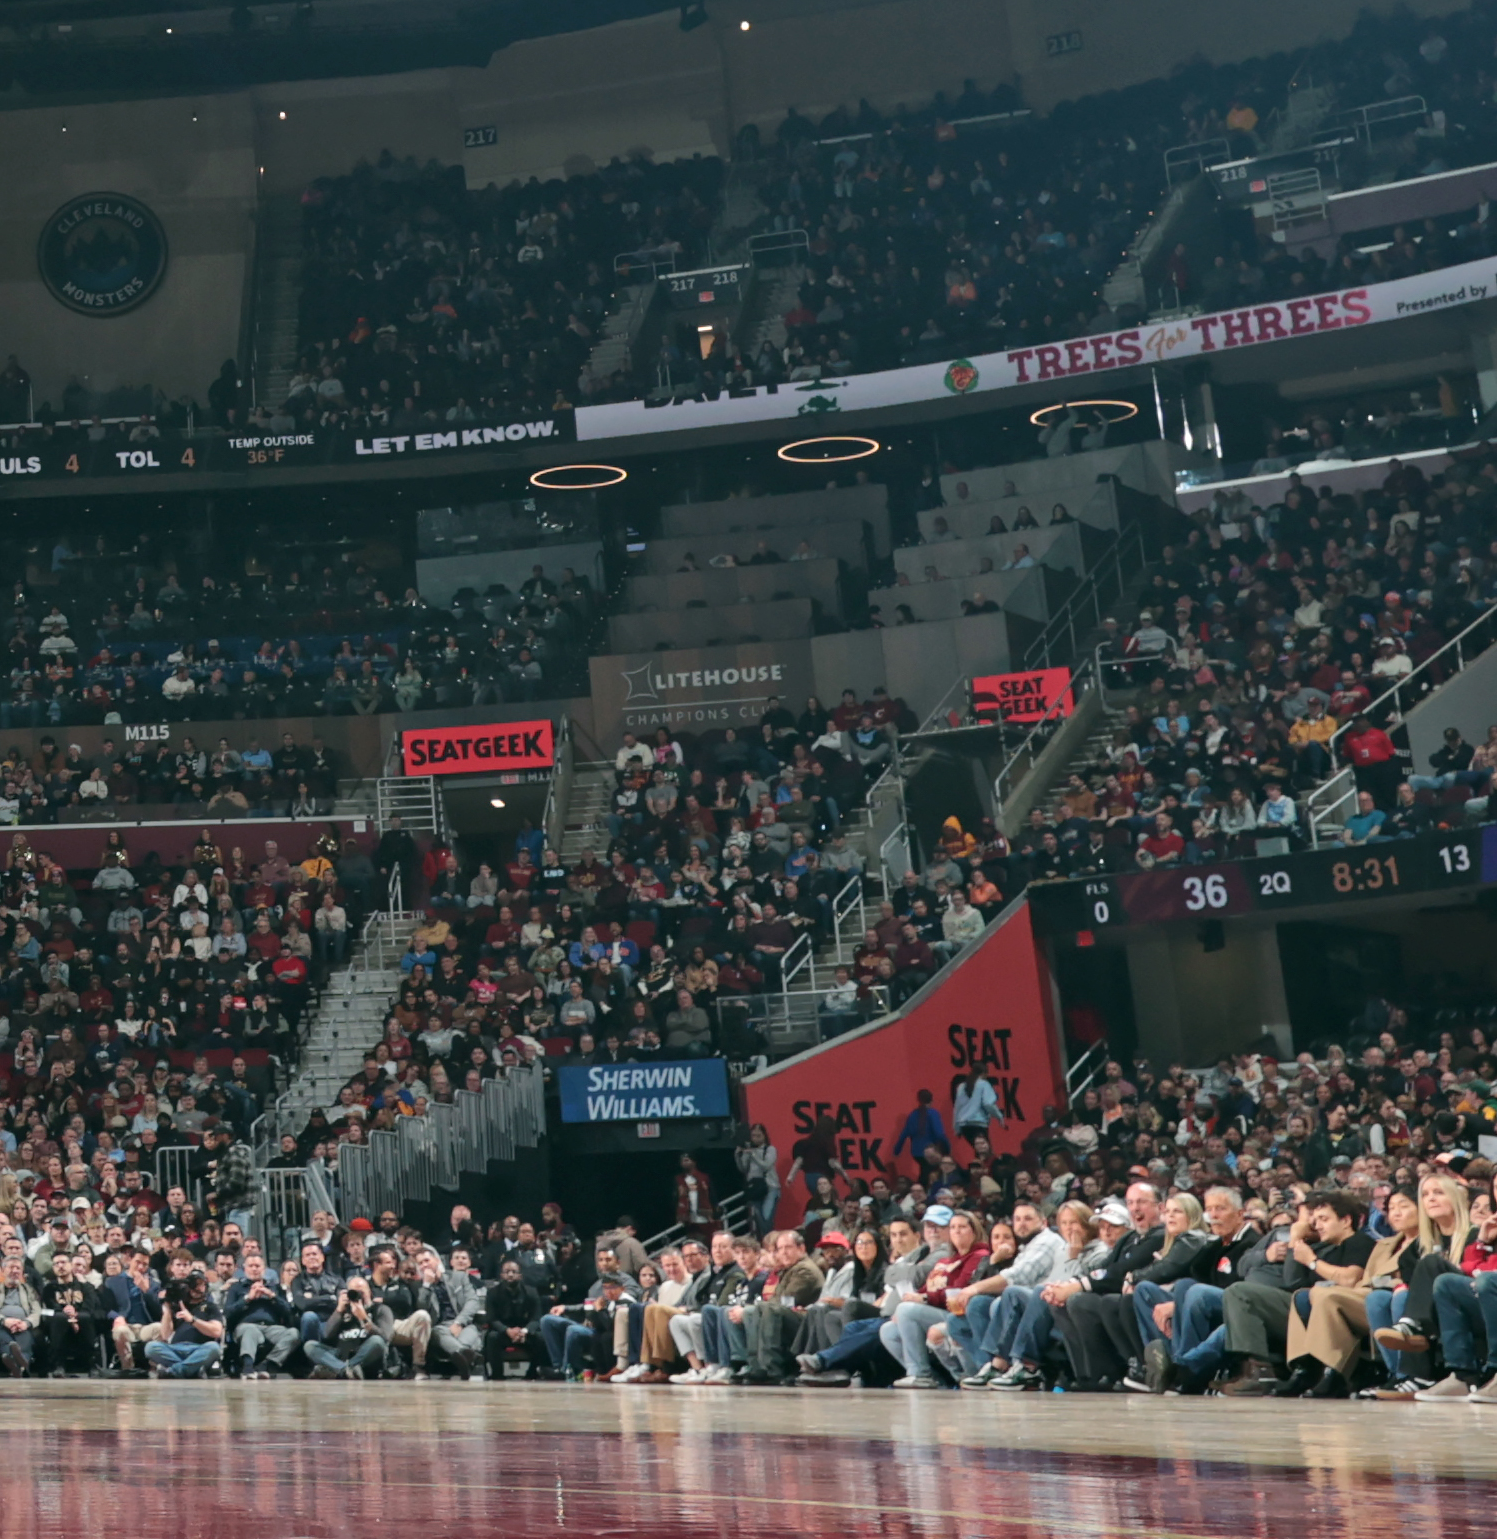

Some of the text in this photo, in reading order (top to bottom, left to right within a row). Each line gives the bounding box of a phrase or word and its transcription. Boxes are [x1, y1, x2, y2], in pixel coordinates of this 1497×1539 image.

[1220, 167, 1247, 183] 218
[58, 203, 144, 233] CLEVELAND
[670, 278, 696, 292] 217
[713, 271, 738, 286] 218
[62, 277, 143, 306] MONSTERS
[1007, 283, 1487, 384] TREES For THREES Presented by
[228, 434, 315, 449] TEMP OUTSIDE
[356, 420, 559, 455] LET EM KNOW.
[65, 454, 79, 472] 4
[116, 450, 160, 468] TOL
[181, 448, 195, 467] 4
[655, 664, 782, 690] LITEHOUSE
[999, 676, 1044, 698] SEAT
[626, 708, 730, 726] CHAMPIONS
[125, 725, 170, 741] M115
[411, 730, 545, 766] SEATGEEK
[1086, 883, 1109, 895] FLS
[1183, 844, 1470, 911] 36 2Q 8:31 13
[1094, 901, 1109, 923] 0
[948, 1024, 1011, 1071] SEAT
[587, 1067, 691, 1092] SHERWIN
[792, 1101, 877, 1134] SEAT
